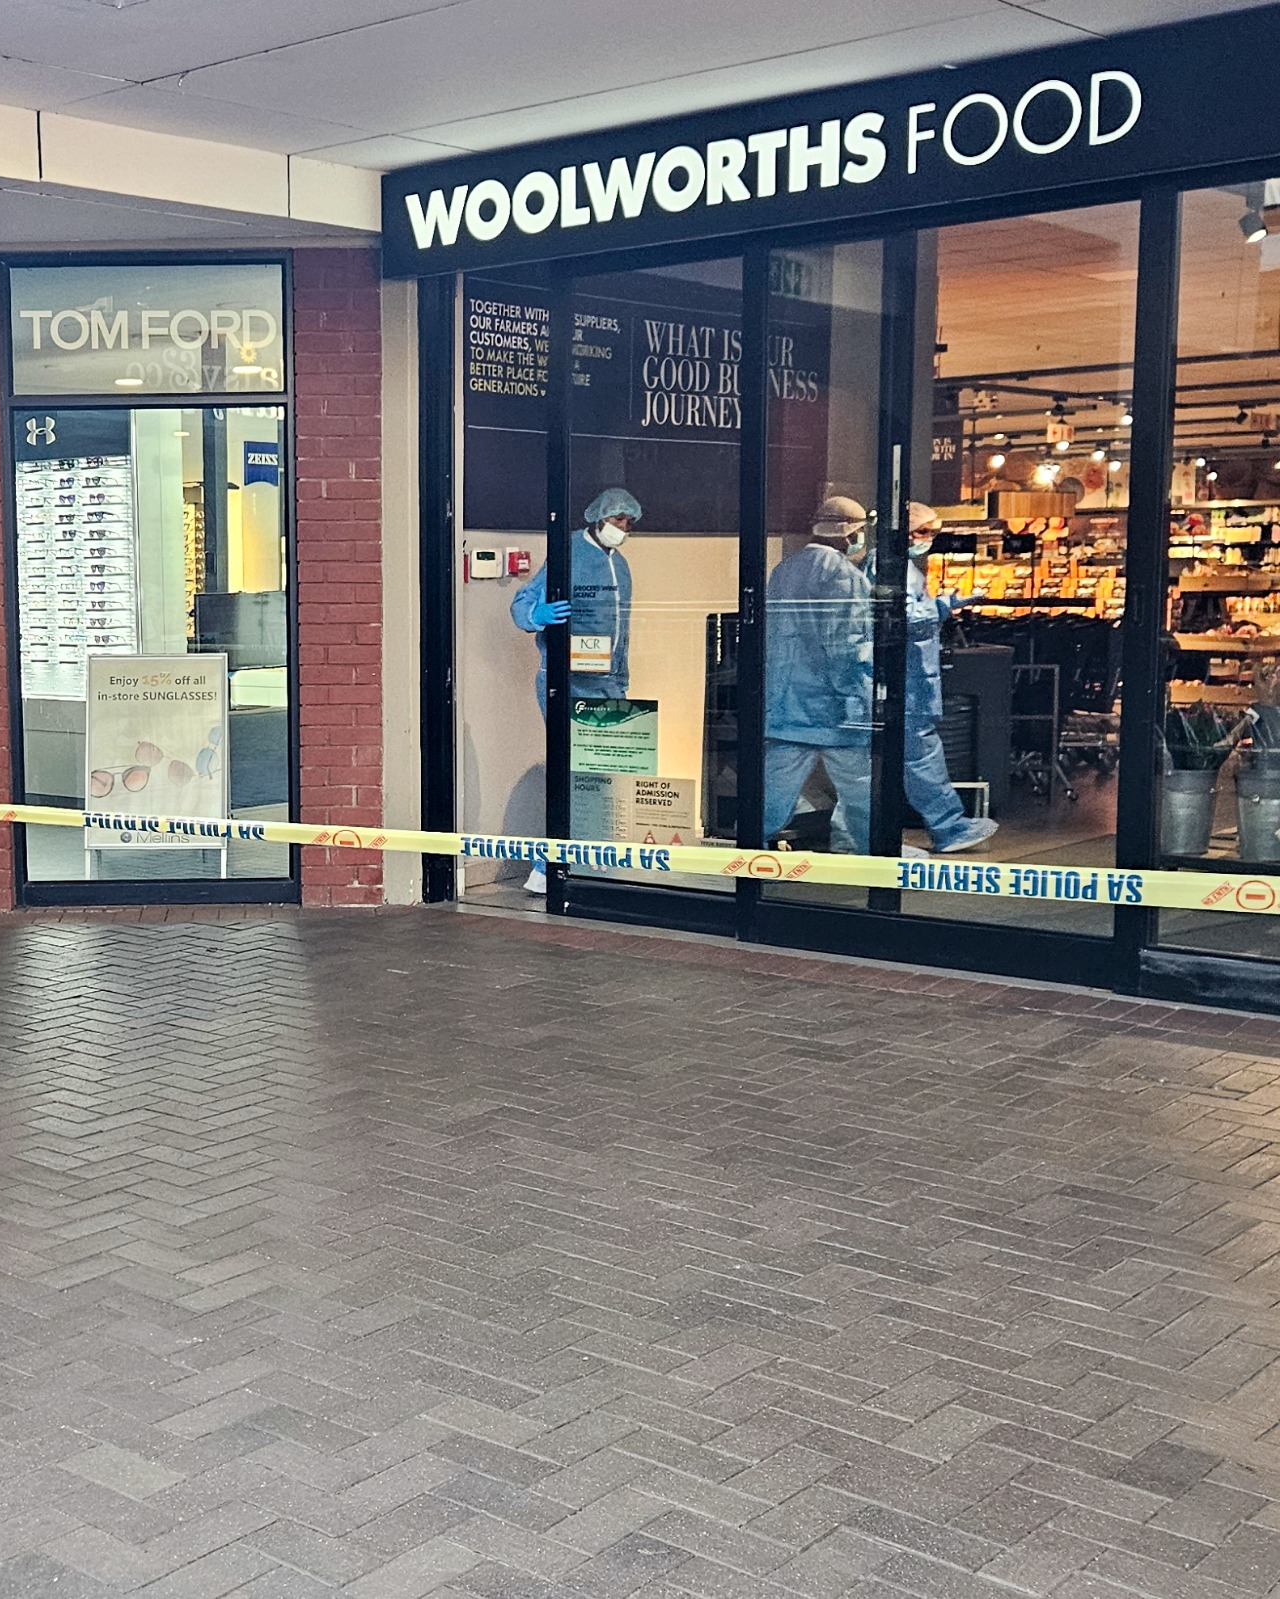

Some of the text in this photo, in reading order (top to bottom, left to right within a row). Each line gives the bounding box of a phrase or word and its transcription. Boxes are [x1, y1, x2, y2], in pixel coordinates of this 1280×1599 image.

[405, 70, 1142, 250] WOOLWORTHS FOOD
[469, 298, 621, 334] TOGETHER WITH SUPPLIERS,
[469, 315, 492, 330] OUR
[495, 318, 538, 336] FARMERS
[20, 309, 277, 350] TOM FORD
[469, 331, 532, 353] CUSTOMERS,
[535, 339, 549, 353] WE
[643, 319, 794, 368] WHAT IS UR
[470, 346, 484, 360] TO
[487, 349, 514, 364] MAKE
[517, 352, 534, 366] THE
[470, 362, 503, 378] BETTER
[506, 366, 534, 381] PLACE
[643, 355, 710, 393] GOOD
[469, 378, 538, 396] GENERATIONS
[641, 390, 742, 429] JOURNEY
[247, 453, 278, 465] ZEISS
[580, 638, 600, 650] NCR
[109, 673, 206, 688] Enjoy 15% off all
[98, 691, 217, 701] in-store SUNGLASSES!
[635, 780, 658, 789] RIGHT
[635, 790, 680, 799] ADMISSION
[635, 798, 673, 807] RESERVED
[136, 831, 190, 844] Mellins
[460, 836, 671, 872] SA POLICE SERVICE
[897, 861, 1143, 903] SA POLICE SERVICE
